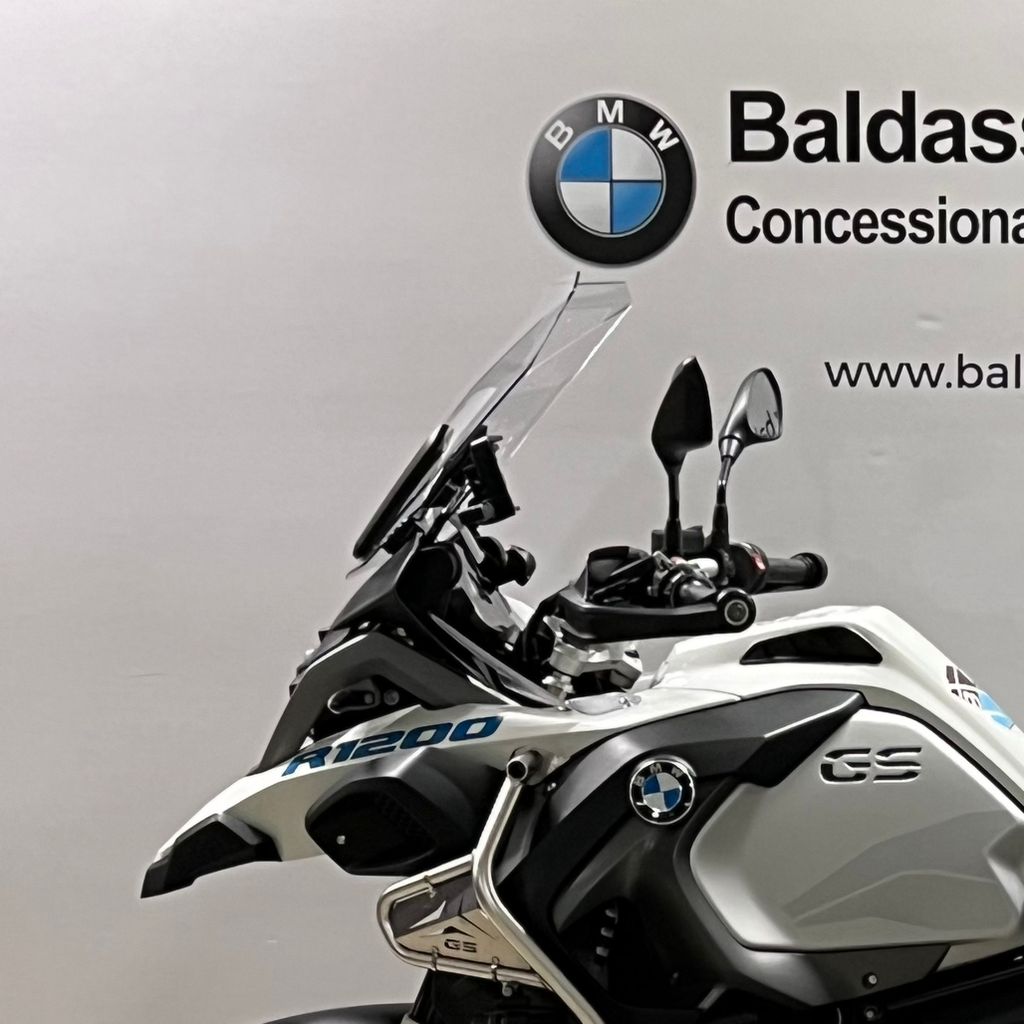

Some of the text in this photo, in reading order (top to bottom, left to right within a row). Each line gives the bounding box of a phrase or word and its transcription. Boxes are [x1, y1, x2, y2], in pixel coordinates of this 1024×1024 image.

[544, 99, 680, 152] BMW
[281, 715, 504, 777] R1200
[819, 746, 922, 785] GS
[443, 938, 477, 953] GS
